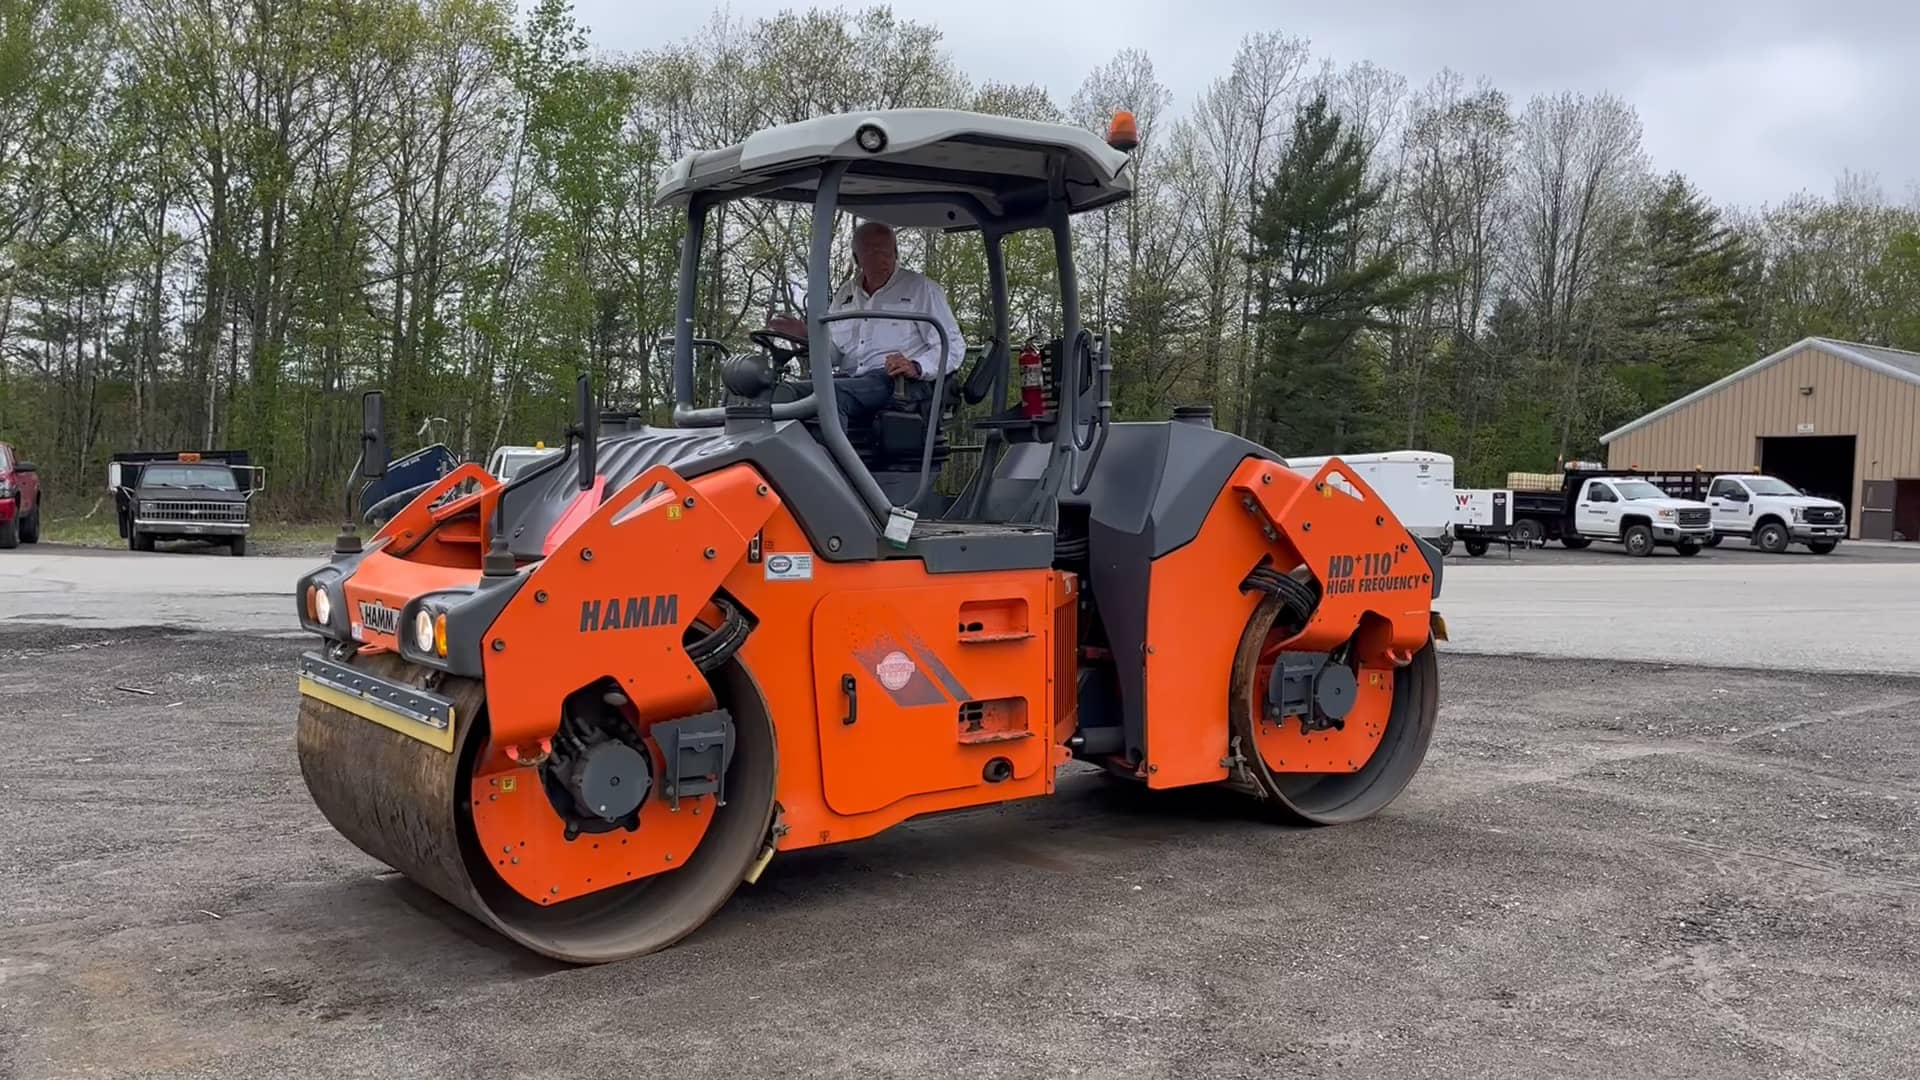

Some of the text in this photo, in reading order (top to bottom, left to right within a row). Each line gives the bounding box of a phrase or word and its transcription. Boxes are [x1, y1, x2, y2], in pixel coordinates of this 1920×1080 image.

[1326, 575, 1421, 595] HIGH FREQUENCY
[365, 605, 394, 631] HAMM
[580, 594, 678, 632] HAMM
